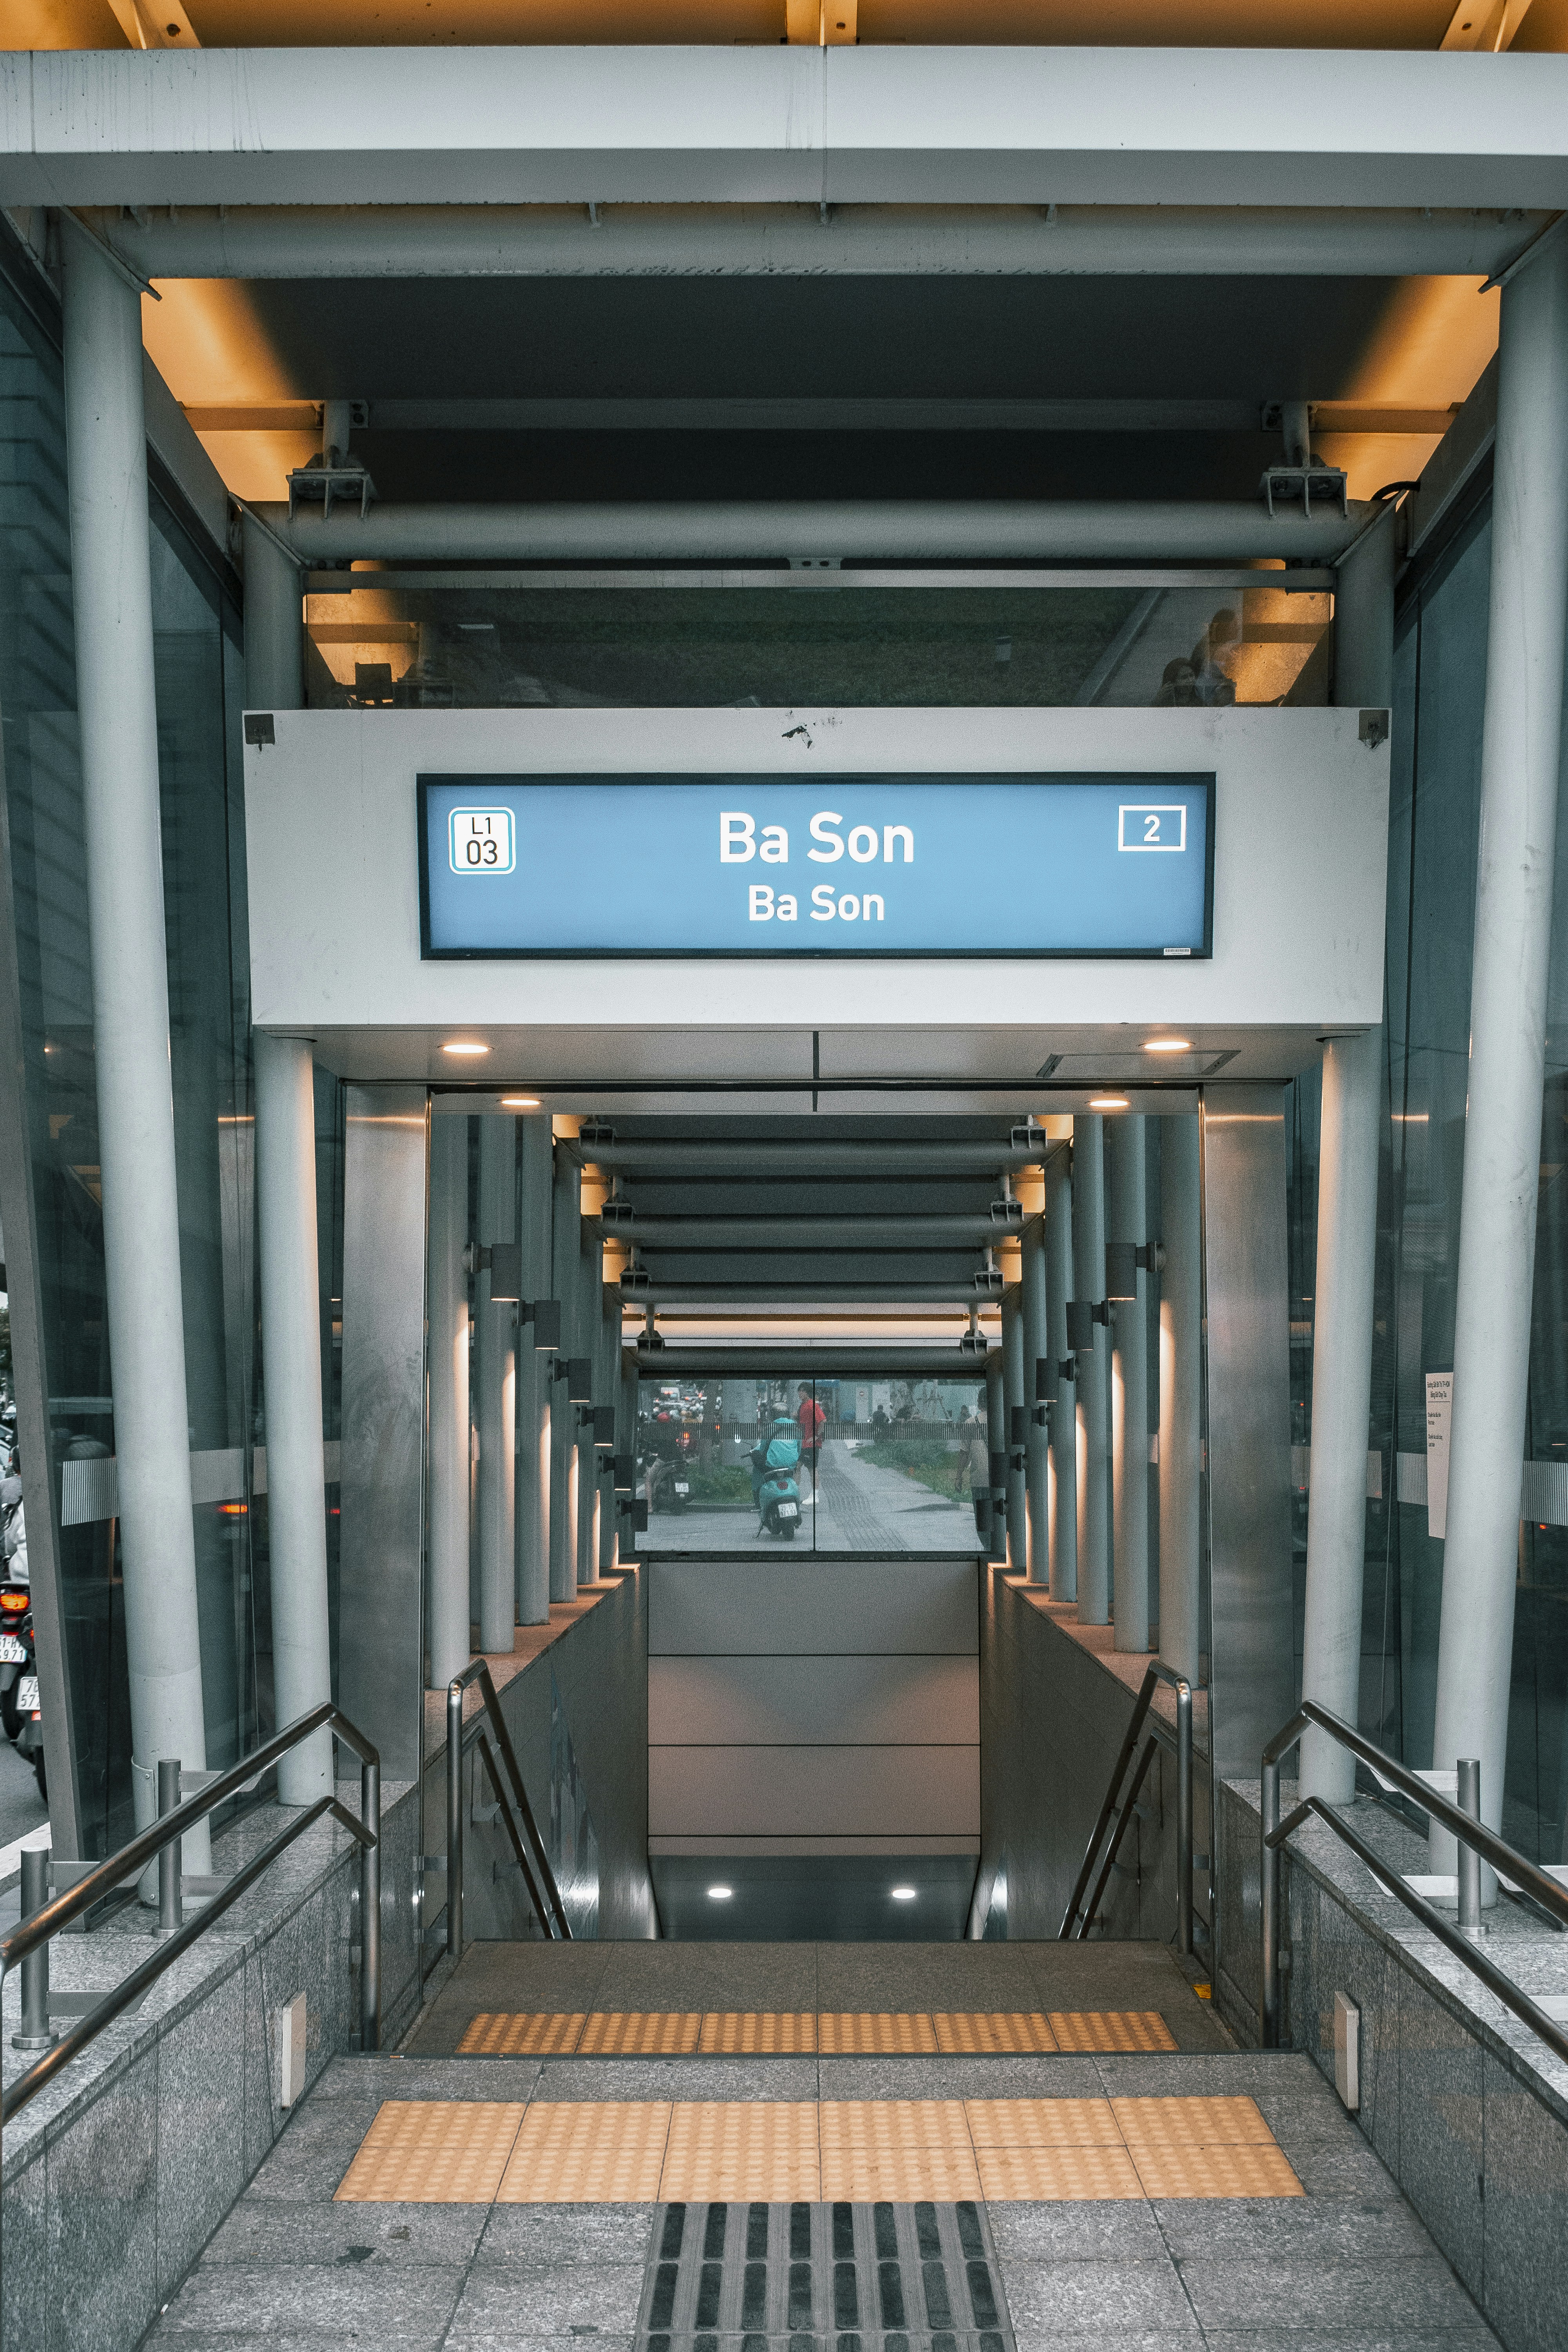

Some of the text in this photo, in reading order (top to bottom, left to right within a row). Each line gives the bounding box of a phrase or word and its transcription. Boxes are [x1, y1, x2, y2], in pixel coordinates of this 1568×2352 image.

[472, 817, 490, 834] L1
[720, 811, 914, 863] Ba Son
[1143, 814, 1160, 841] 2
[467, 840, 497, 865] 03
[749, 884, 884, 921] Ba Son
[20, 1694, 40, 1707] 57
